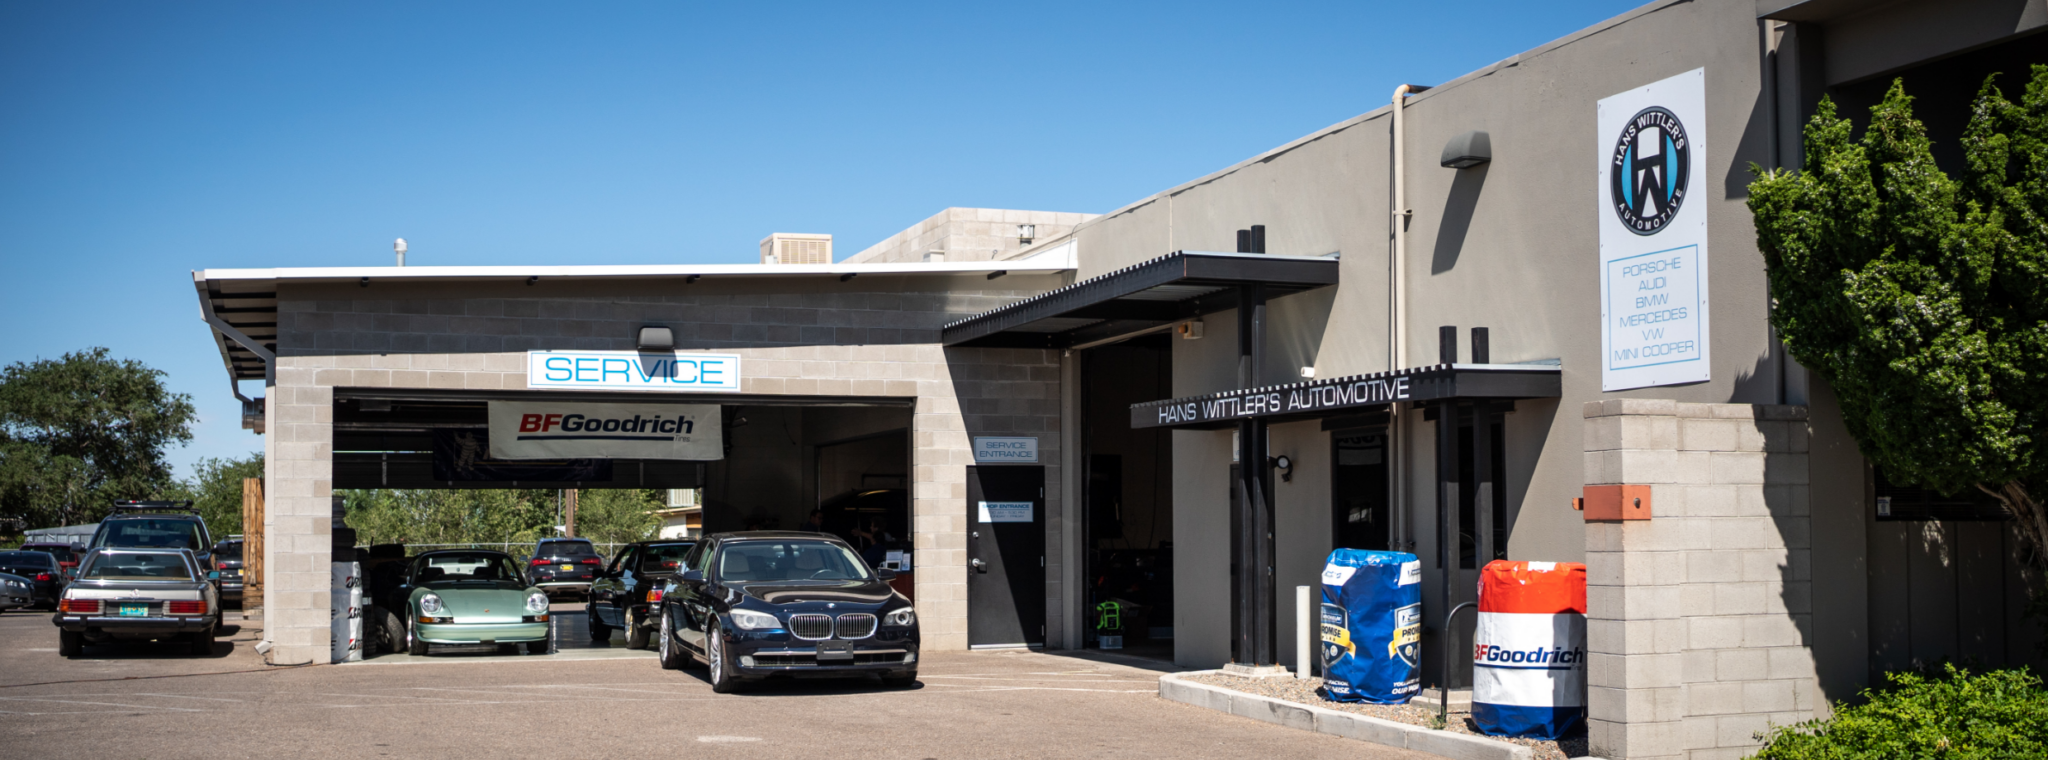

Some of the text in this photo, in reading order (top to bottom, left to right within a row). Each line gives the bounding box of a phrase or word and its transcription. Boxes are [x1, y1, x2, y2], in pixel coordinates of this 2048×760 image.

[1615, 112, 1685, 165] HANS WITTLER'S
[1619, 188, 1682, 230] AUTOMOTIVE
[1623, 257, 1681, 278] PORSCHE
[1638, 276, 1667, 292] AUDI
[1636, 293, 1669, 308] BMW
[1620, 307, 1687, 328] MERCEDES
[1642, 327, 1664, 341] VW
[1615, 340, 1694, 361] MINI COOPER
[545, 357, 724, 384] SERVICE
[1158, 377, 1410, 423] HANS WITTLER'S AUTOMOTIVE
[519, 413, 694, 434] BFGoodrich
[674, 435, 691, 443] Tires
[1321, 626, 1341, 638] ROMISE
